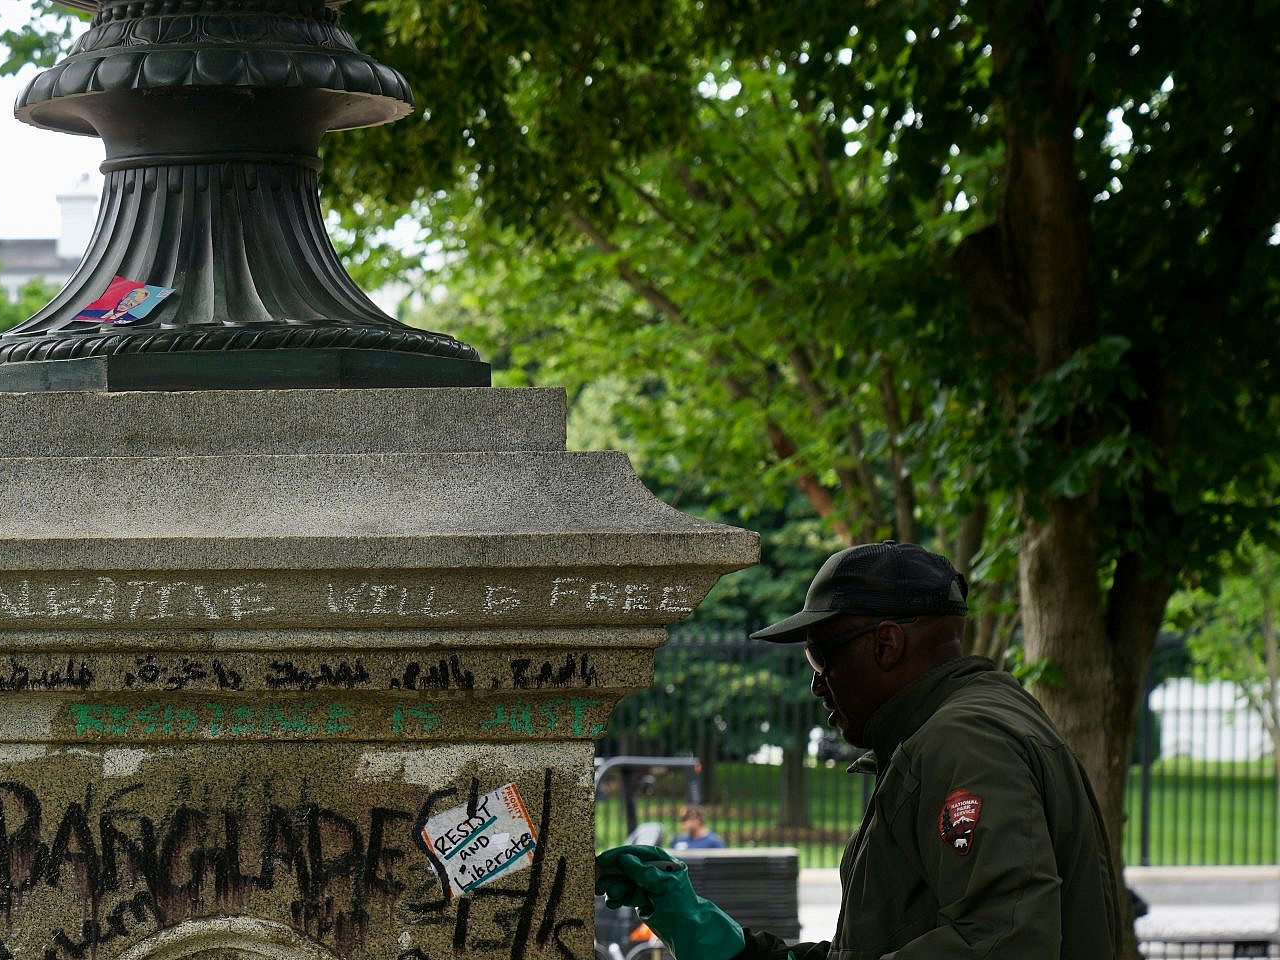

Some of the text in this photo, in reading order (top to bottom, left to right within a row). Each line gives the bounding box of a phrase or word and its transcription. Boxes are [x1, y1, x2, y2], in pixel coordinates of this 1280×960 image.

[392, 702, 440, 735] IS
[951, 799, 978, 808] NATIONAL
[433, 796, 491, 855] RESIST
